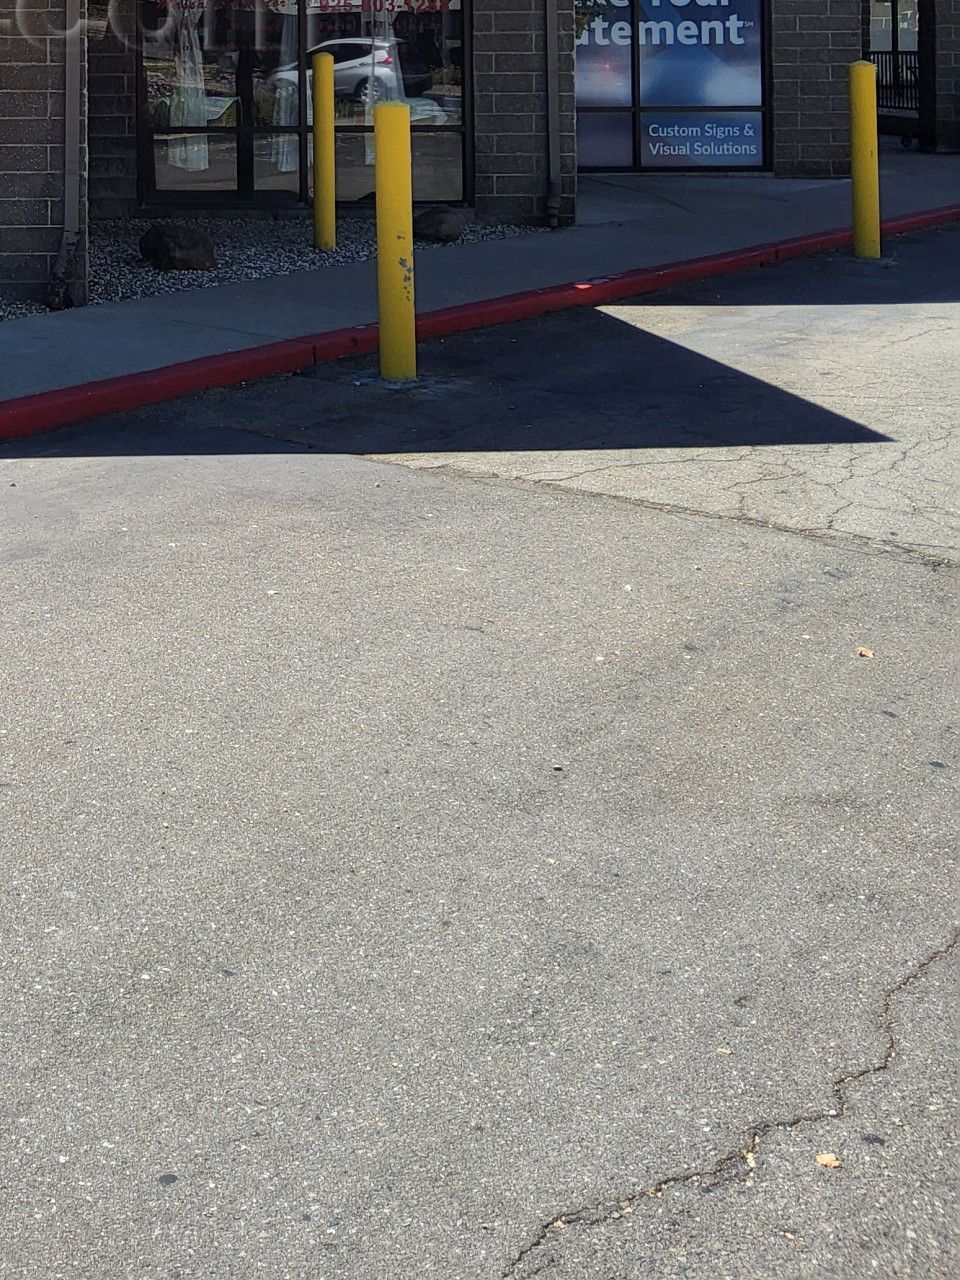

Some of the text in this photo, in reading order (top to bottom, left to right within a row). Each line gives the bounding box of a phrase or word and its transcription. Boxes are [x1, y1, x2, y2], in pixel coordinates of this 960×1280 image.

[649, 123, 755, 139] Custom Signs &
[649, 142, 757, 156] Visual Solutions
